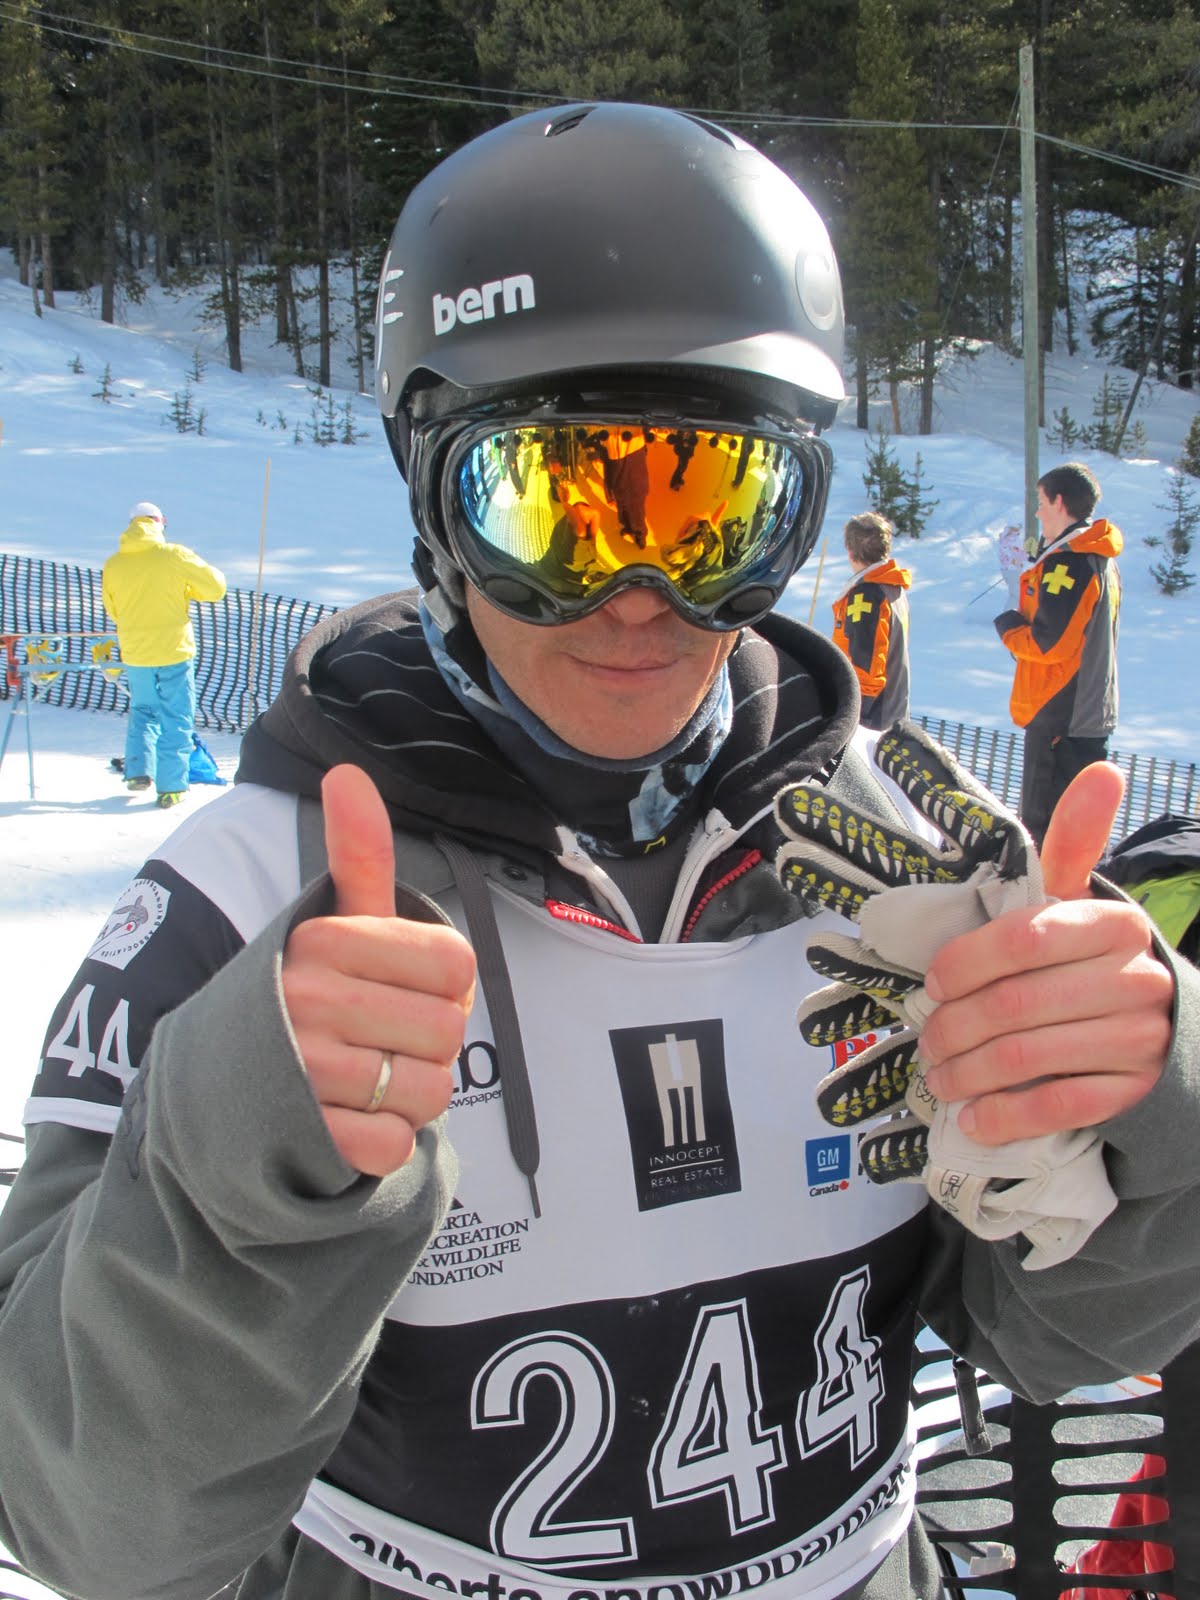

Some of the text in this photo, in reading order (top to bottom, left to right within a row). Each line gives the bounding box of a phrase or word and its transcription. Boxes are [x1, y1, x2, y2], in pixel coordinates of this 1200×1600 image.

[433, 274, 535, 336] bern
[36, 983, 140, 1094] 44
[649, 1145, 721, 1166] INNOCEPT
[817, 1148, 839, 1166] GM
[651, 1166, 725, 1188] REAL ESTATE
[809, 1184, 840, 1197] Canada
[427, 1218, 529, 1250] CREATION
[431, 1238, 521, 1267] WILDLIFE
[407, 1260, 504, 1286] UNDATION
